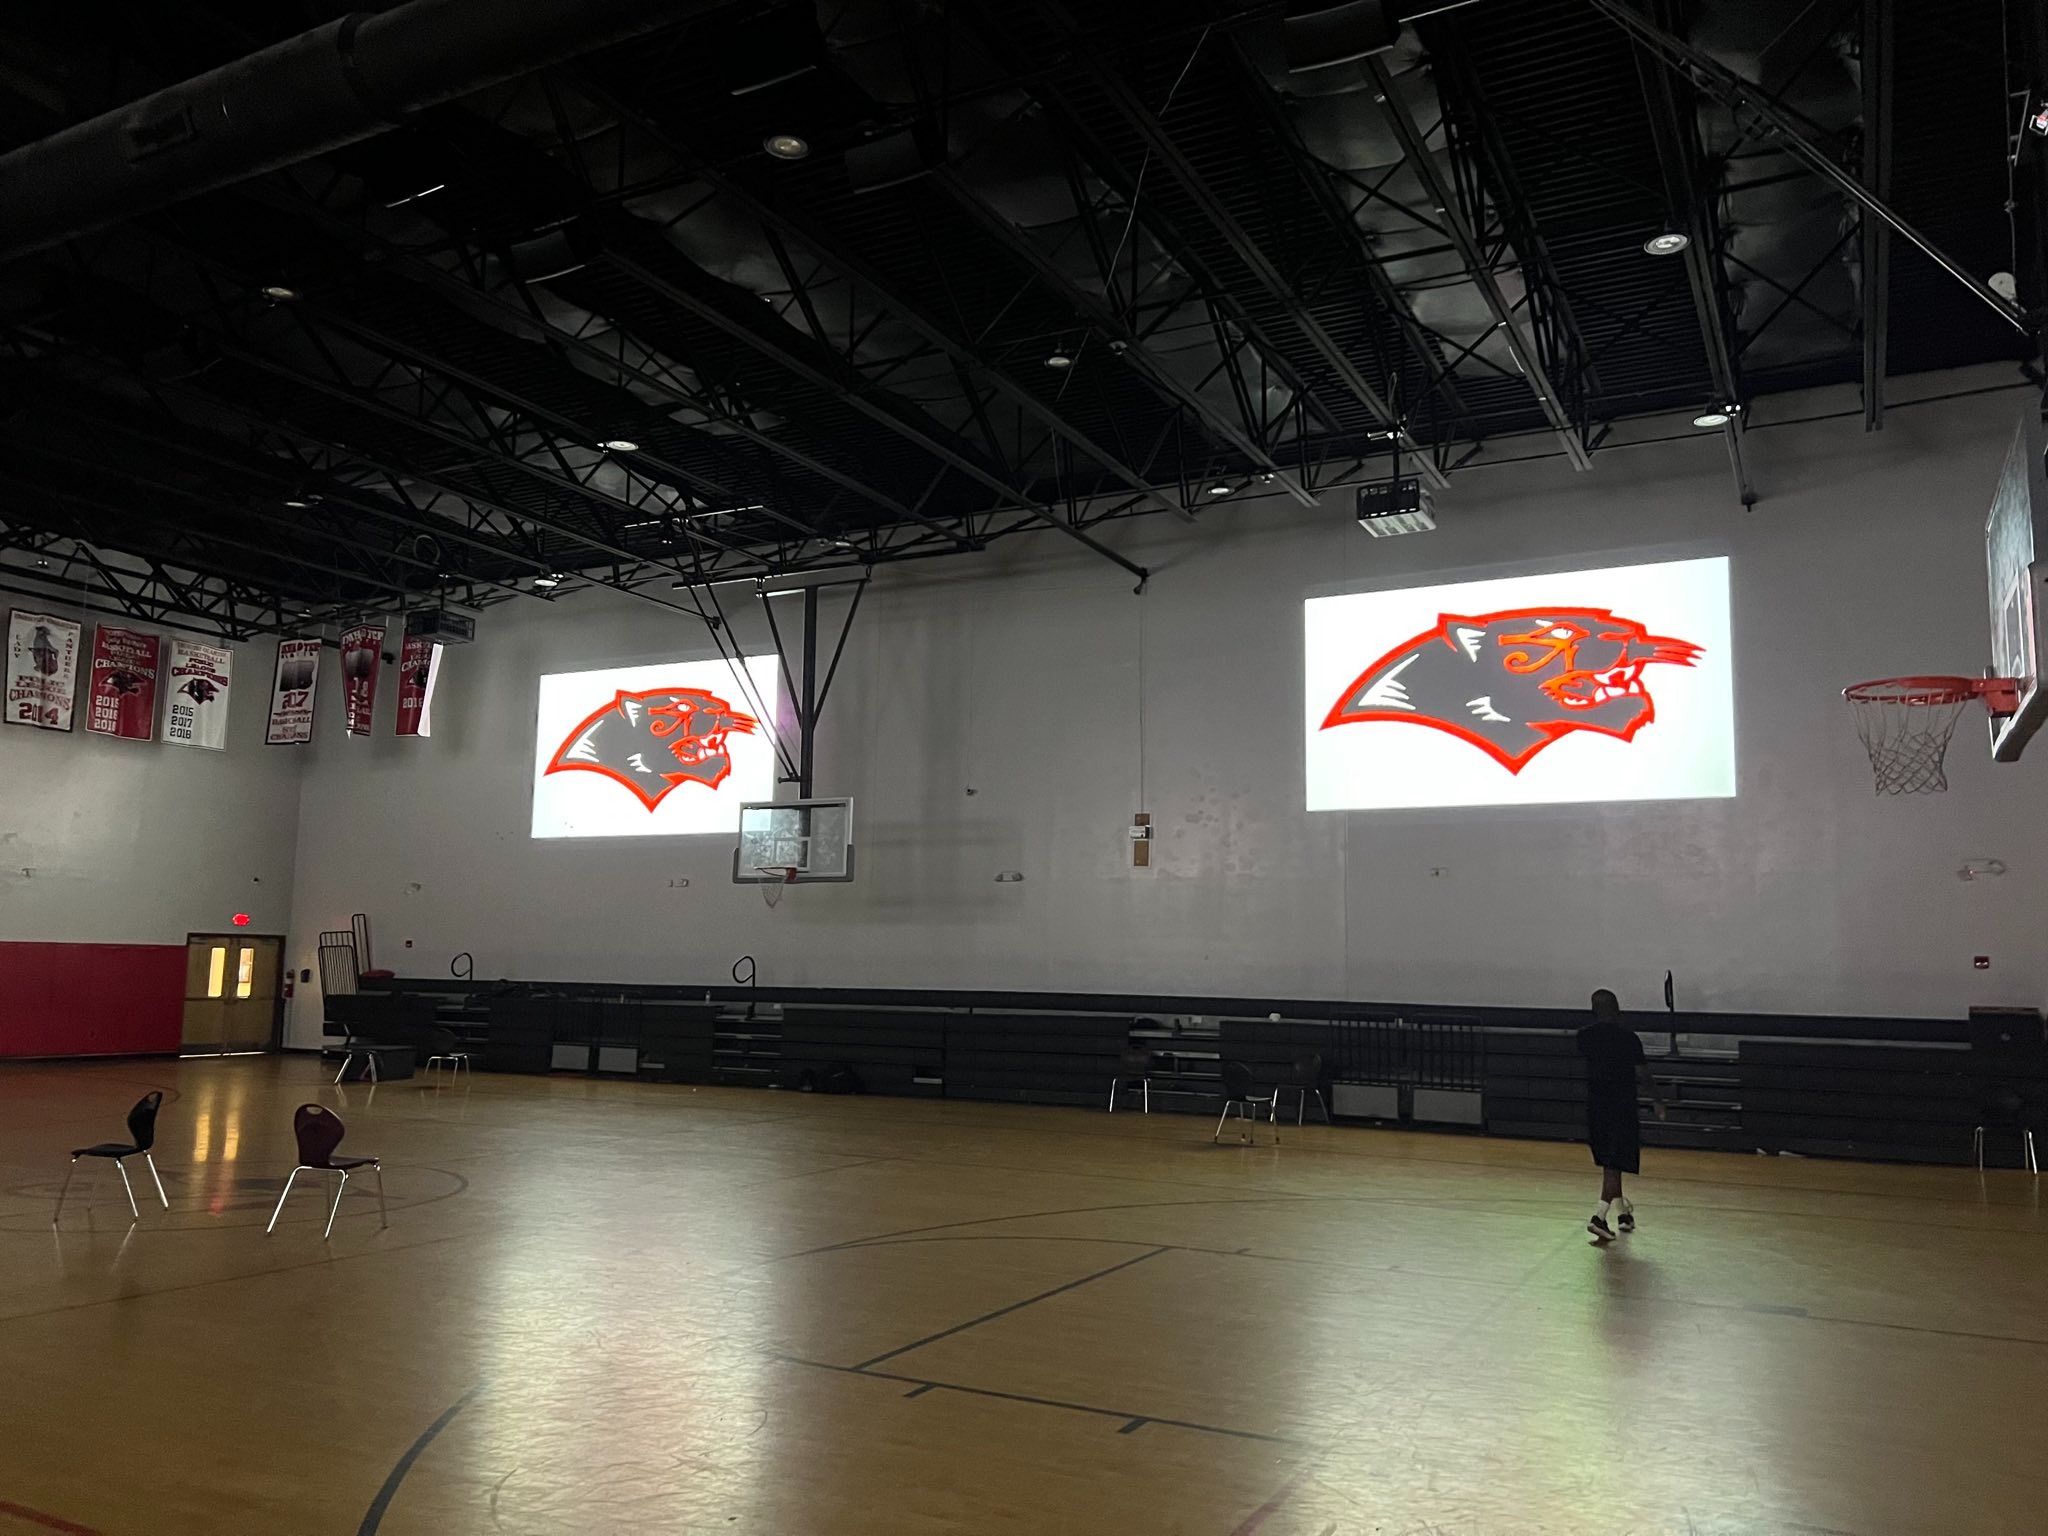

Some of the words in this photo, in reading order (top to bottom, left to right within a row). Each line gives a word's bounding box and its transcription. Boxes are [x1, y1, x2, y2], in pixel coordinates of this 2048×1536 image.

[95, 658, 156, 680] CHAMPIONS
[171, 667, 228, 687] CHAMPIONS
[172, 704, 194, 717] 2015
[171, 715, 193, 728] 2017
[169, 727, 192, 739] 2018
